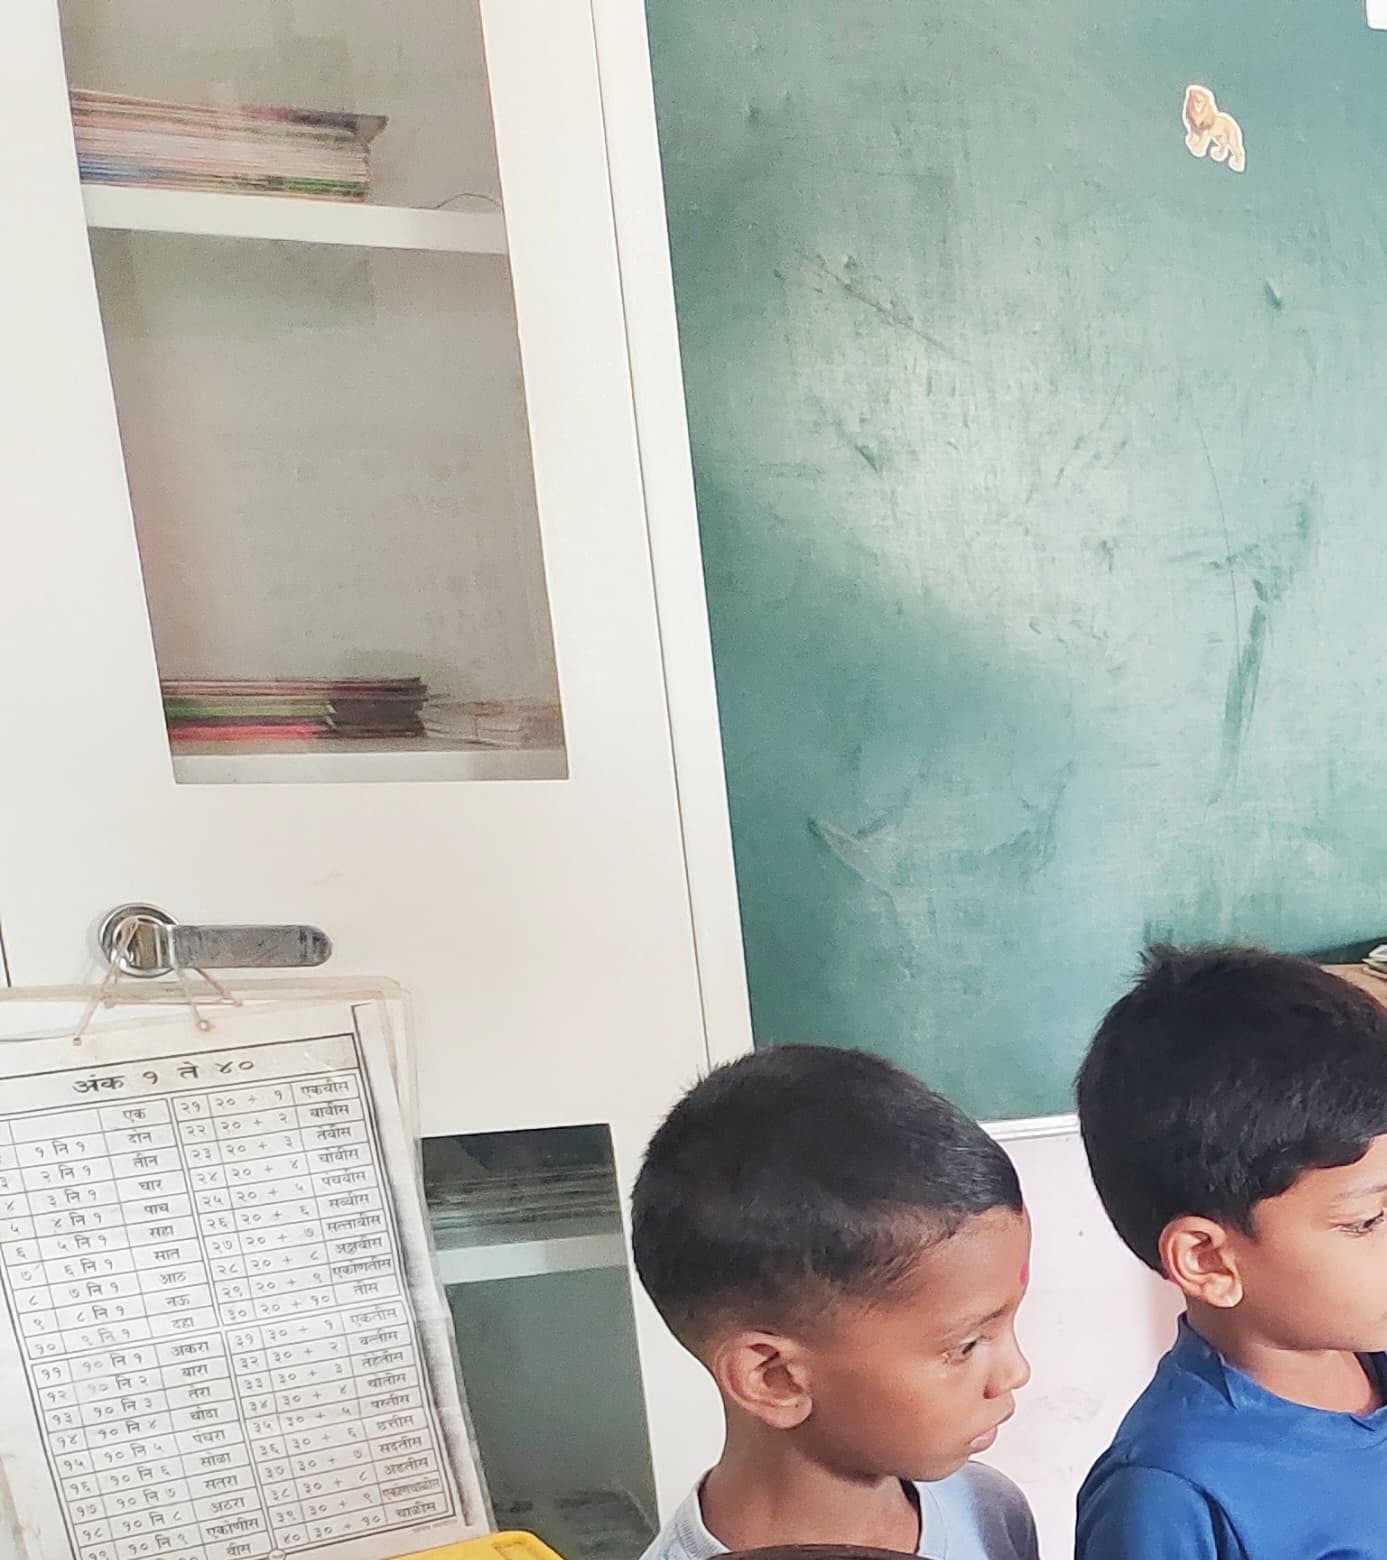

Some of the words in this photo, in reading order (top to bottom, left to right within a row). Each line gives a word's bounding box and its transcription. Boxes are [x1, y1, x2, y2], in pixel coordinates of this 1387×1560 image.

[69, 1072, 127, 1093] अंक
[141, 1070, 160, 1086] १
[174, 1060, 201, 1080] ते
[216, 1059, 256, 1074] ४०
[299, 1079, 349, 1098] एकवीस
[180, 1101, 200, 1113] २१
[308, 1101, 349, 1118] बावीस
[122, 1108, 147, 1123] एक
[126, 1128, 152, 1144] दोन
[186, 1124, 206, 1136] २२
[131, 1150, 158, 1168] तीन
[191, 1147, 211, 1160] २३
[197, 1171, 218, 1184] २४
[137, 1179, 163, 1191] चार
[202, 1194, 223, 1207] २५
[207, 1217, 227, 1229] २६
[148, 1225, 174, 1237] सहा
[212, 1239, 233, 1253] २७
[153, 1248, 180, 1261] सात
[217, 1263, 237, 1275] २८
[160, 1270, 187, 1284] आठ
[222, 1285, 242, 1298] २९
[352, 1279, 378, 1295] तीस
[165, 1293, 190, 1307] नऊ
[227, 1307, 247, 1320] ३०
[348, 1304, 397, 1327] एकतीस
[171, 1317, 194, 1329] दहा
[170, 1340, 209, 1356] अकरा
[41, 1366, 61, 1380] ११
[181, 1364, 209, 1377] बारा
[47, 1389, 66, 1402] १२
[51, 1412, 72, 1426] १३
[374, 1410, 413, 1431] छत्तीस
[56, 1434, 79, 1448] १४
[377, 1431, 422, 1453] सदतीस
[63, 1457, 83, 1471] १५
[198, 1447, 231, 1467] सोळा
[383, 1452, 428, 1475] अडतीस
[69, 1480, 90, 1495] १६
[202, 1474, 238, 1491] सतरा
[76, 1503, 97, 1517] १७
[210, 1496, 245, 1513] अठरा
[394, 1496, 436, 1518] चाळीस
[204, 1512, 259, 1540] एकोणीस
[82, 1527, 103, 1541] १८
[224, 1536, 251, 1557] वीस
